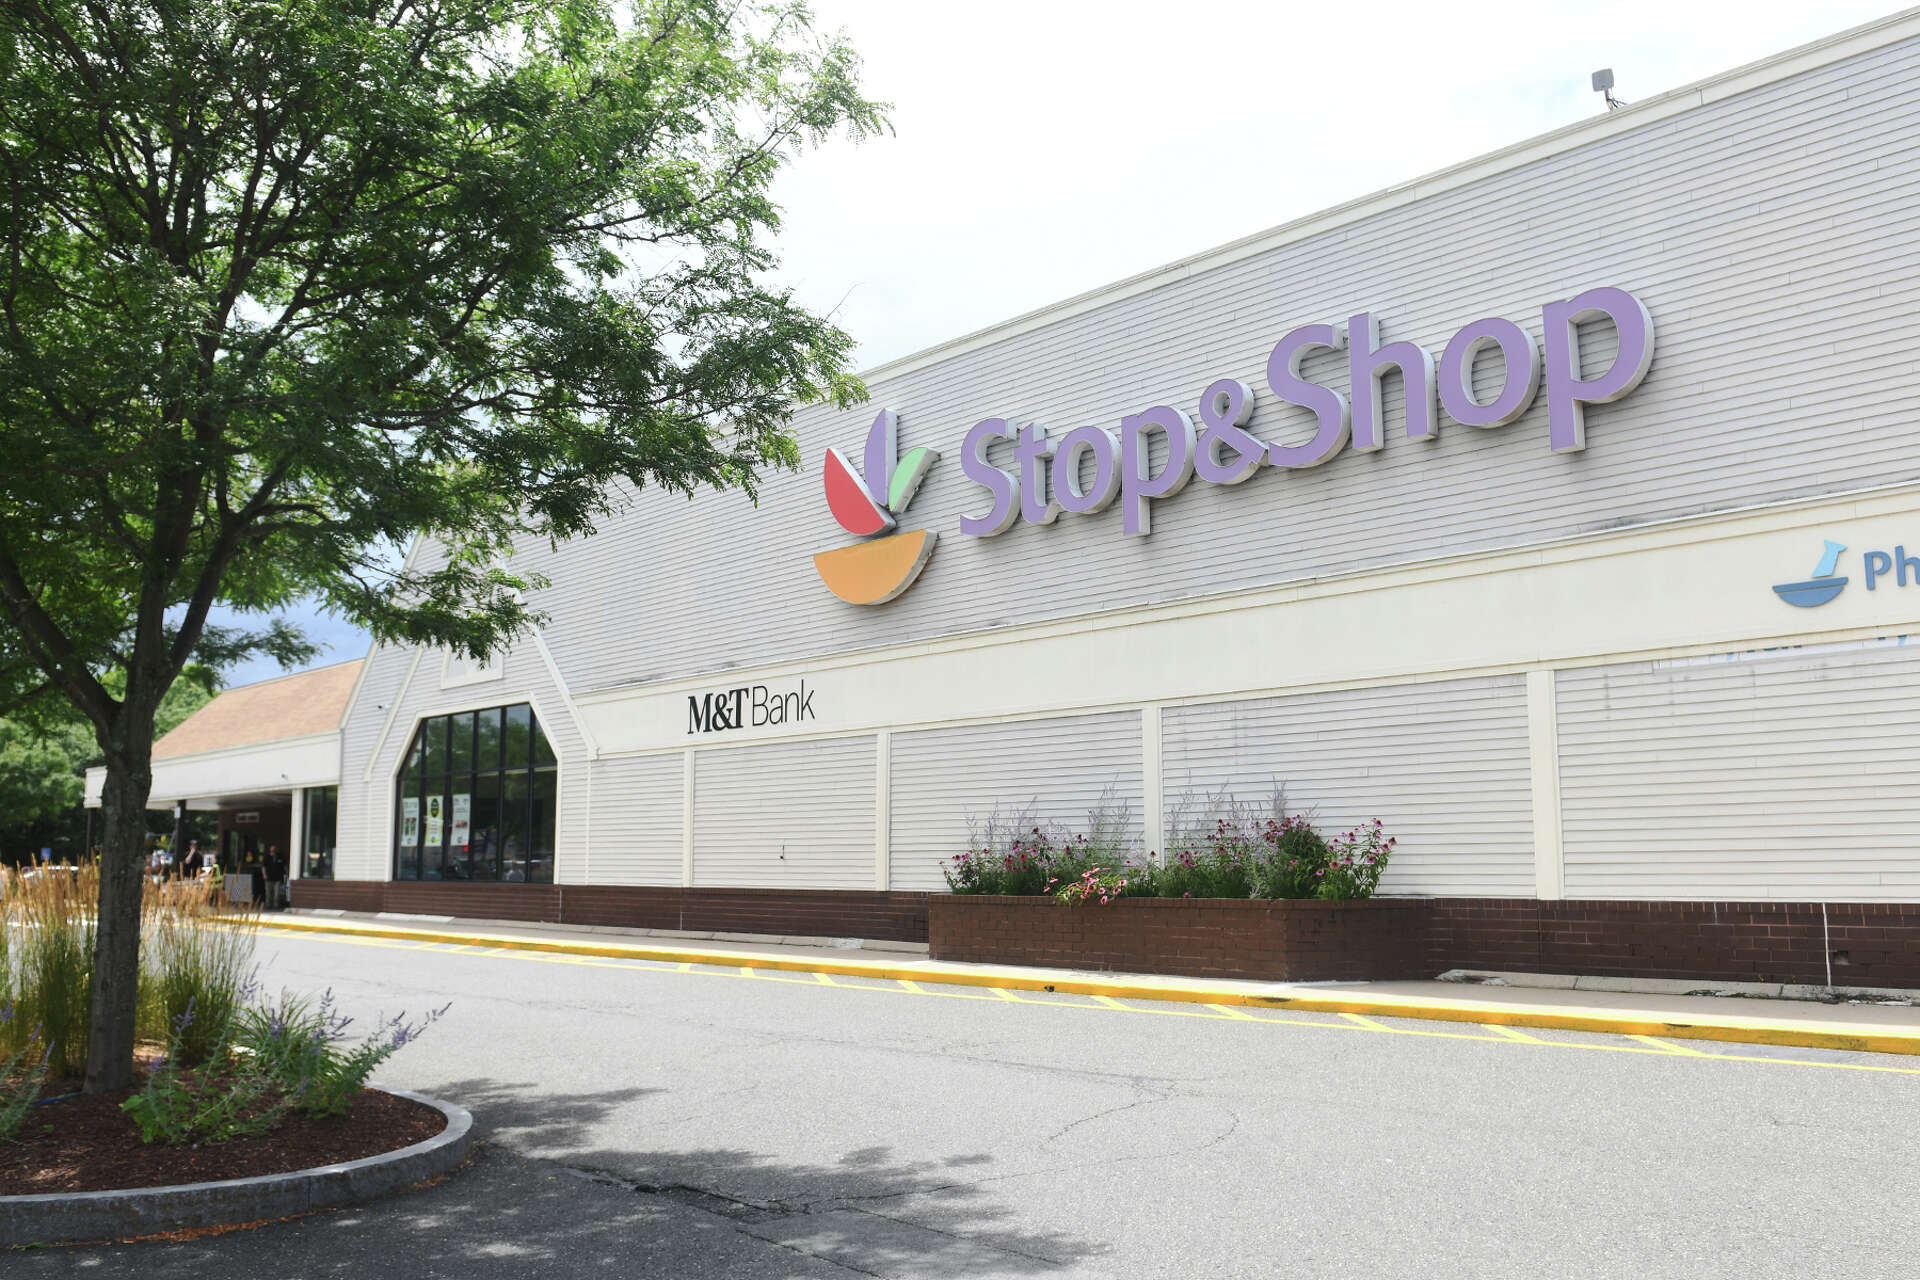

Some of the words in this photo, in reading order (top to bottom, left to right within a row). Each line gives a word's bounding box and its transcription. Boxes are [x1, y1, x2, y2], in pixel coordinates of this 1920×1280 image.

[960, 286, 1655, 536] Stop&Shop
[1864, 545, 1920, 591] Ph
[687, 687, 749, 734] M&T
[752, 679, 815, 726] Bank
